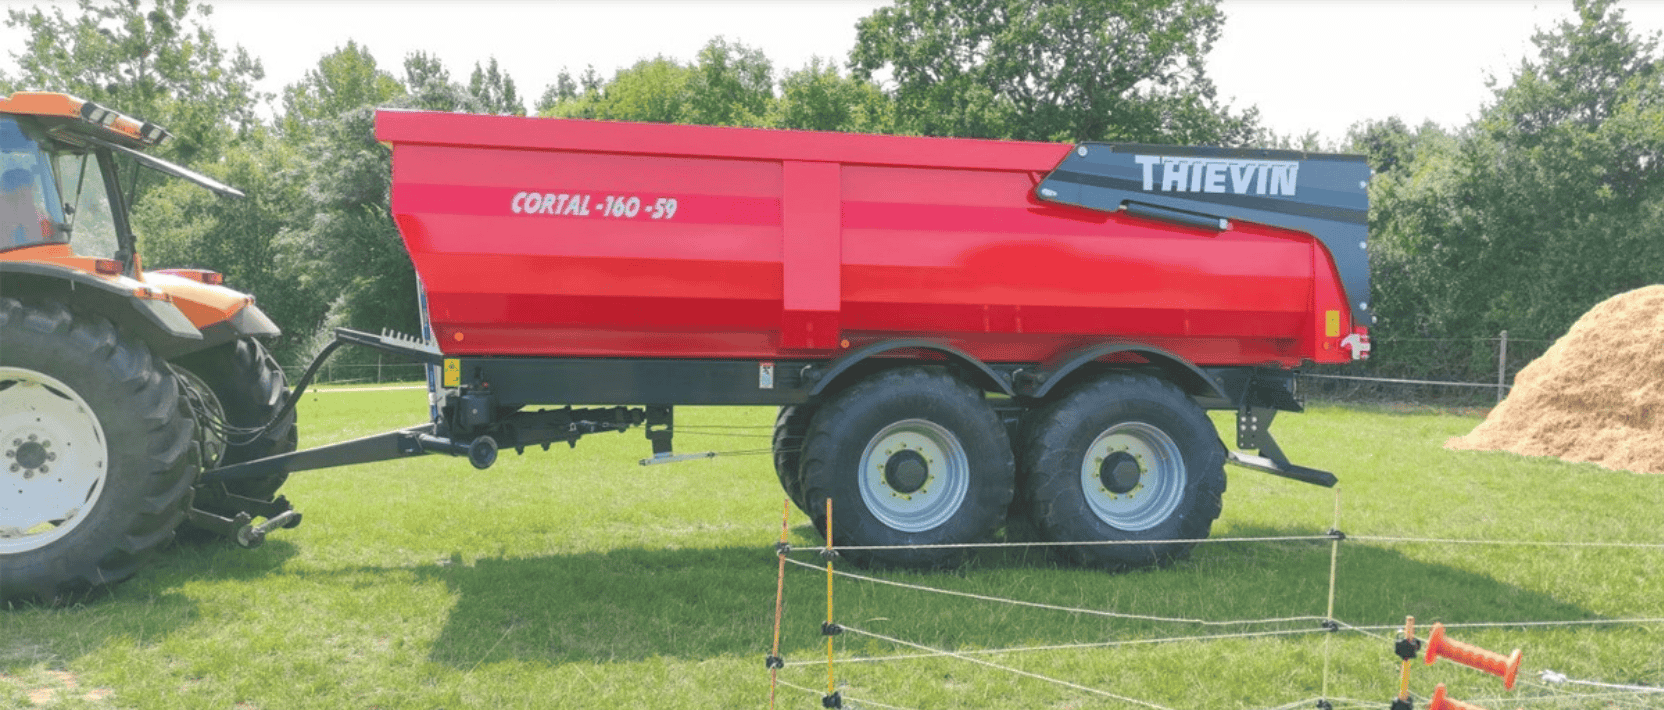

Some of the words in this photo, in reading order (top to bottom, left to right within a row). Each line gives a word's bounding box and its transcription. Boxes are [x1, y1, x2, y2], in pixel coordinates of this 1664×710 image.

[1135, 154, 1299, 196] THIEVIN
[511, 191, 590, 216] CORTAL
[595, 195, 641, 218] -160
